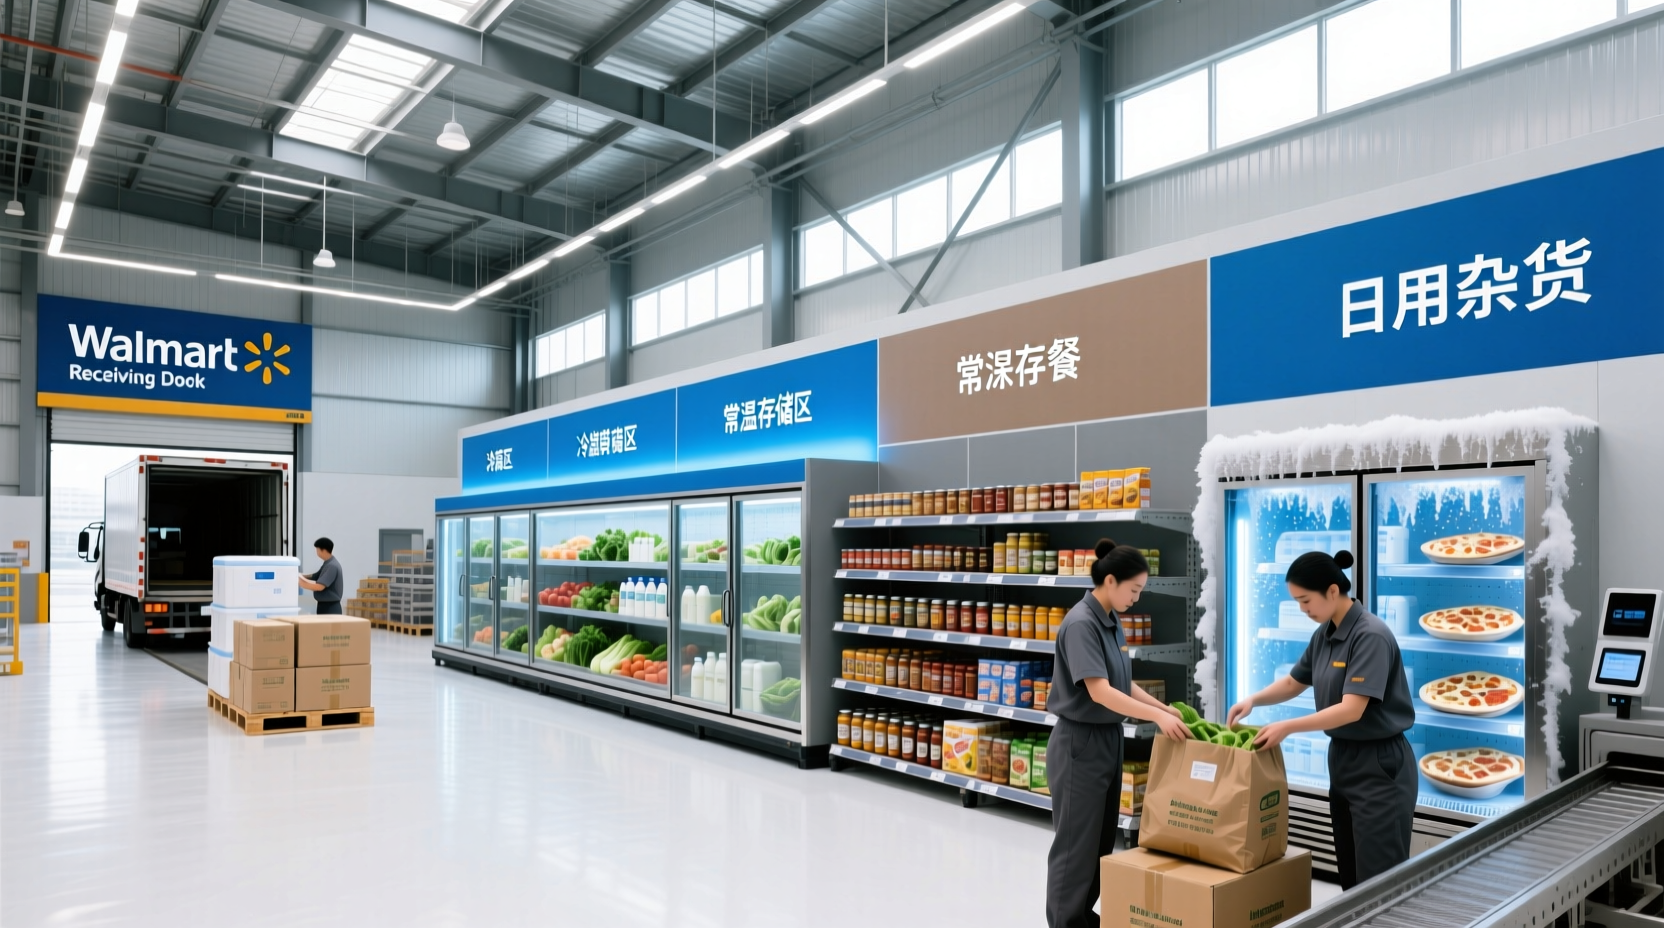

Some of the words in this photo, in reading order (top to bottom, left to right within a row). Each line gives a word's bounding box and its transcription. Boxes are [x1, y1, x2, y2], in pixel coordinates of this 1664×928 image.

[1342, 237, 1593, 339] 日用杂货
[68, 323, 238, 372] Walmart
[69, 363, 156, 390] Receiving
[723, 389, 813, 434] 常温存储区
